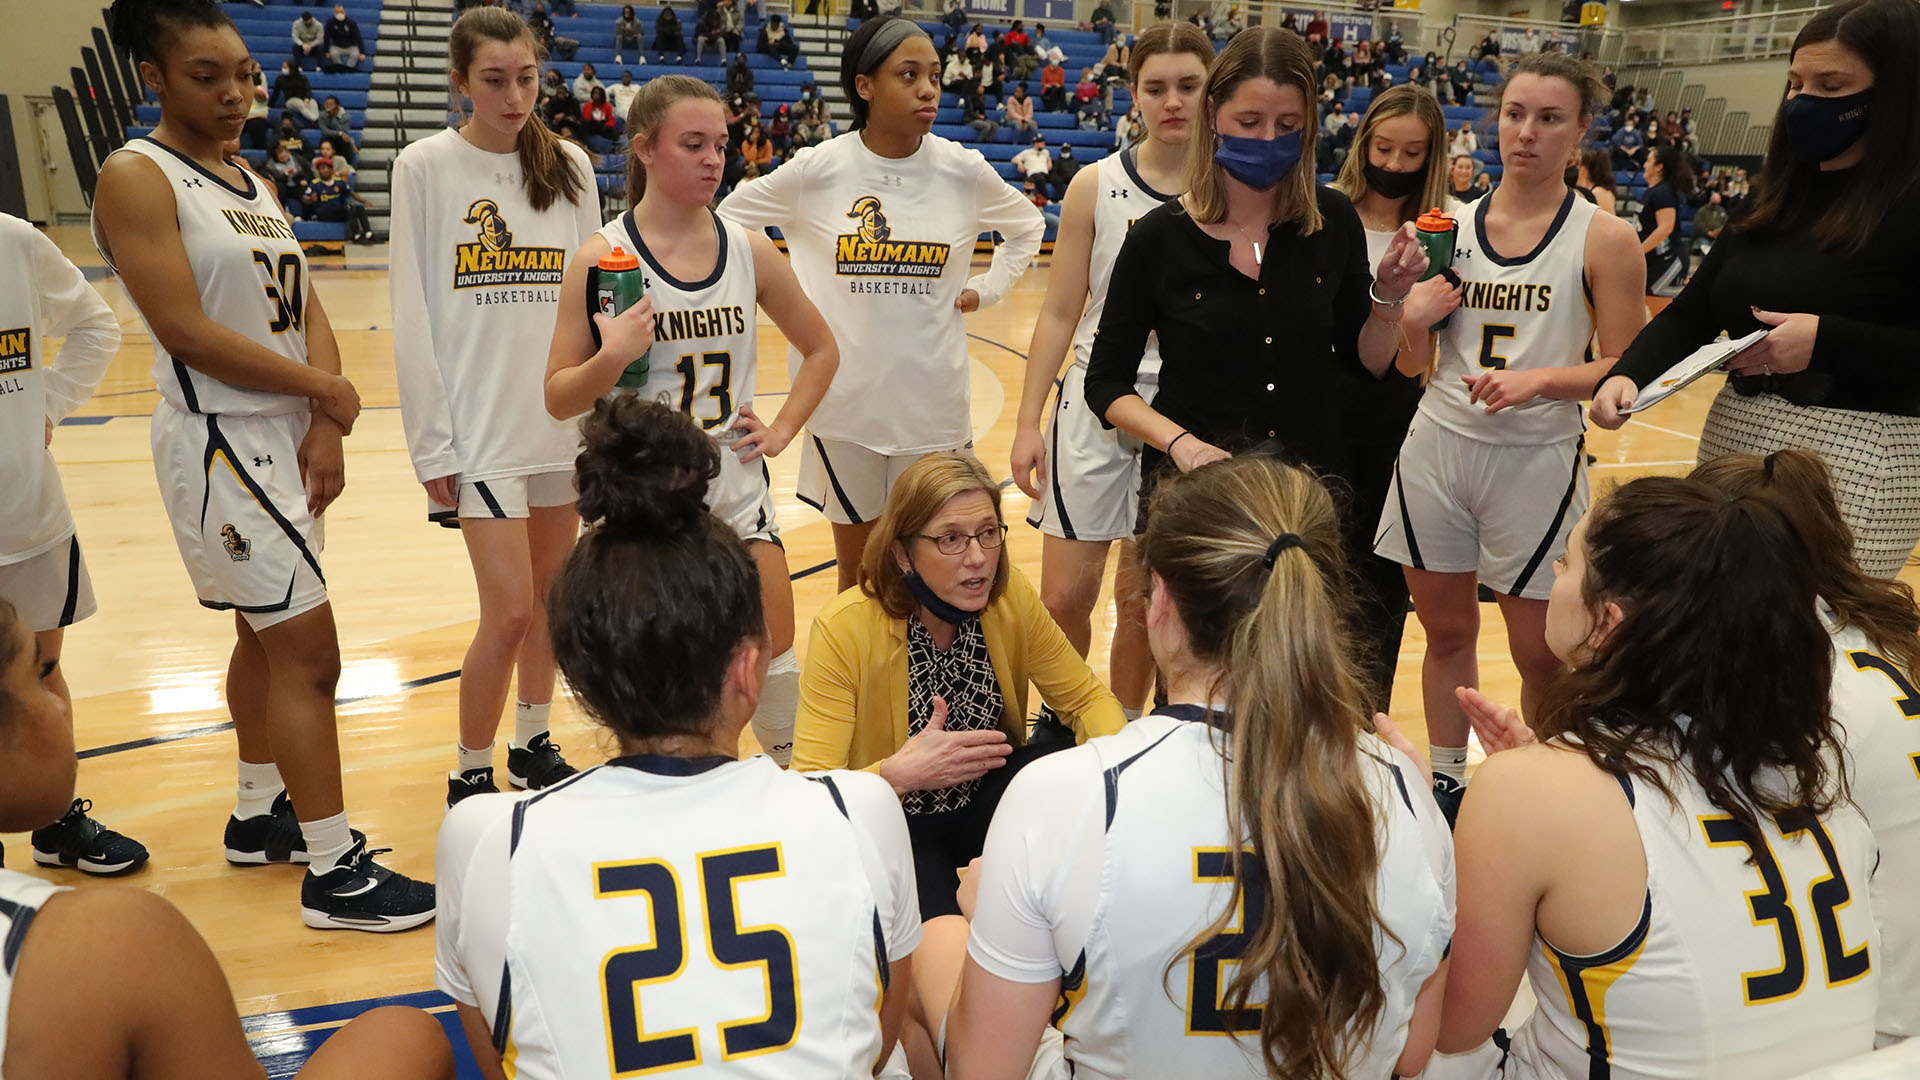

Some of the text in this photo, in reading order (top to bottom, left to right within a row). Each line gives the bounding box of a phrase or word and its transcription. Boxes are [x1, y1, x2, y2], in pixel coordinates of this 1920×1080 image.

[1331, 14, 1373, 26] SECTION
[1343, 25, 1358, 41] H
[221, 208, 296, 241] KNIGHTS
[457, 244, 563, 273] NEUMANN
[838, 236, 949, 265] NEUMANN
[457, 271, 562, 286] UNIVERSITY KNIGHTS
[838, 263, 942, 276] UNIVERSITY KNIGHTS
[250, 248, 304, 336] 30
[475, 290, 558, 306] BASKETBALL
[850, 281, 931, 295] BASKETBALL
[1458, 281, 1552, 312] KNIGHTS
[652, 305, 746, 342] KNIGHTS
[1472, 322, 1518, 381] 5
[673, 350, 735, 432] 13
[1696, 803, 1873, 1007] 32
[1184, 845, 1270, 1037] 2
[591, 840, 803, 1080] 25
